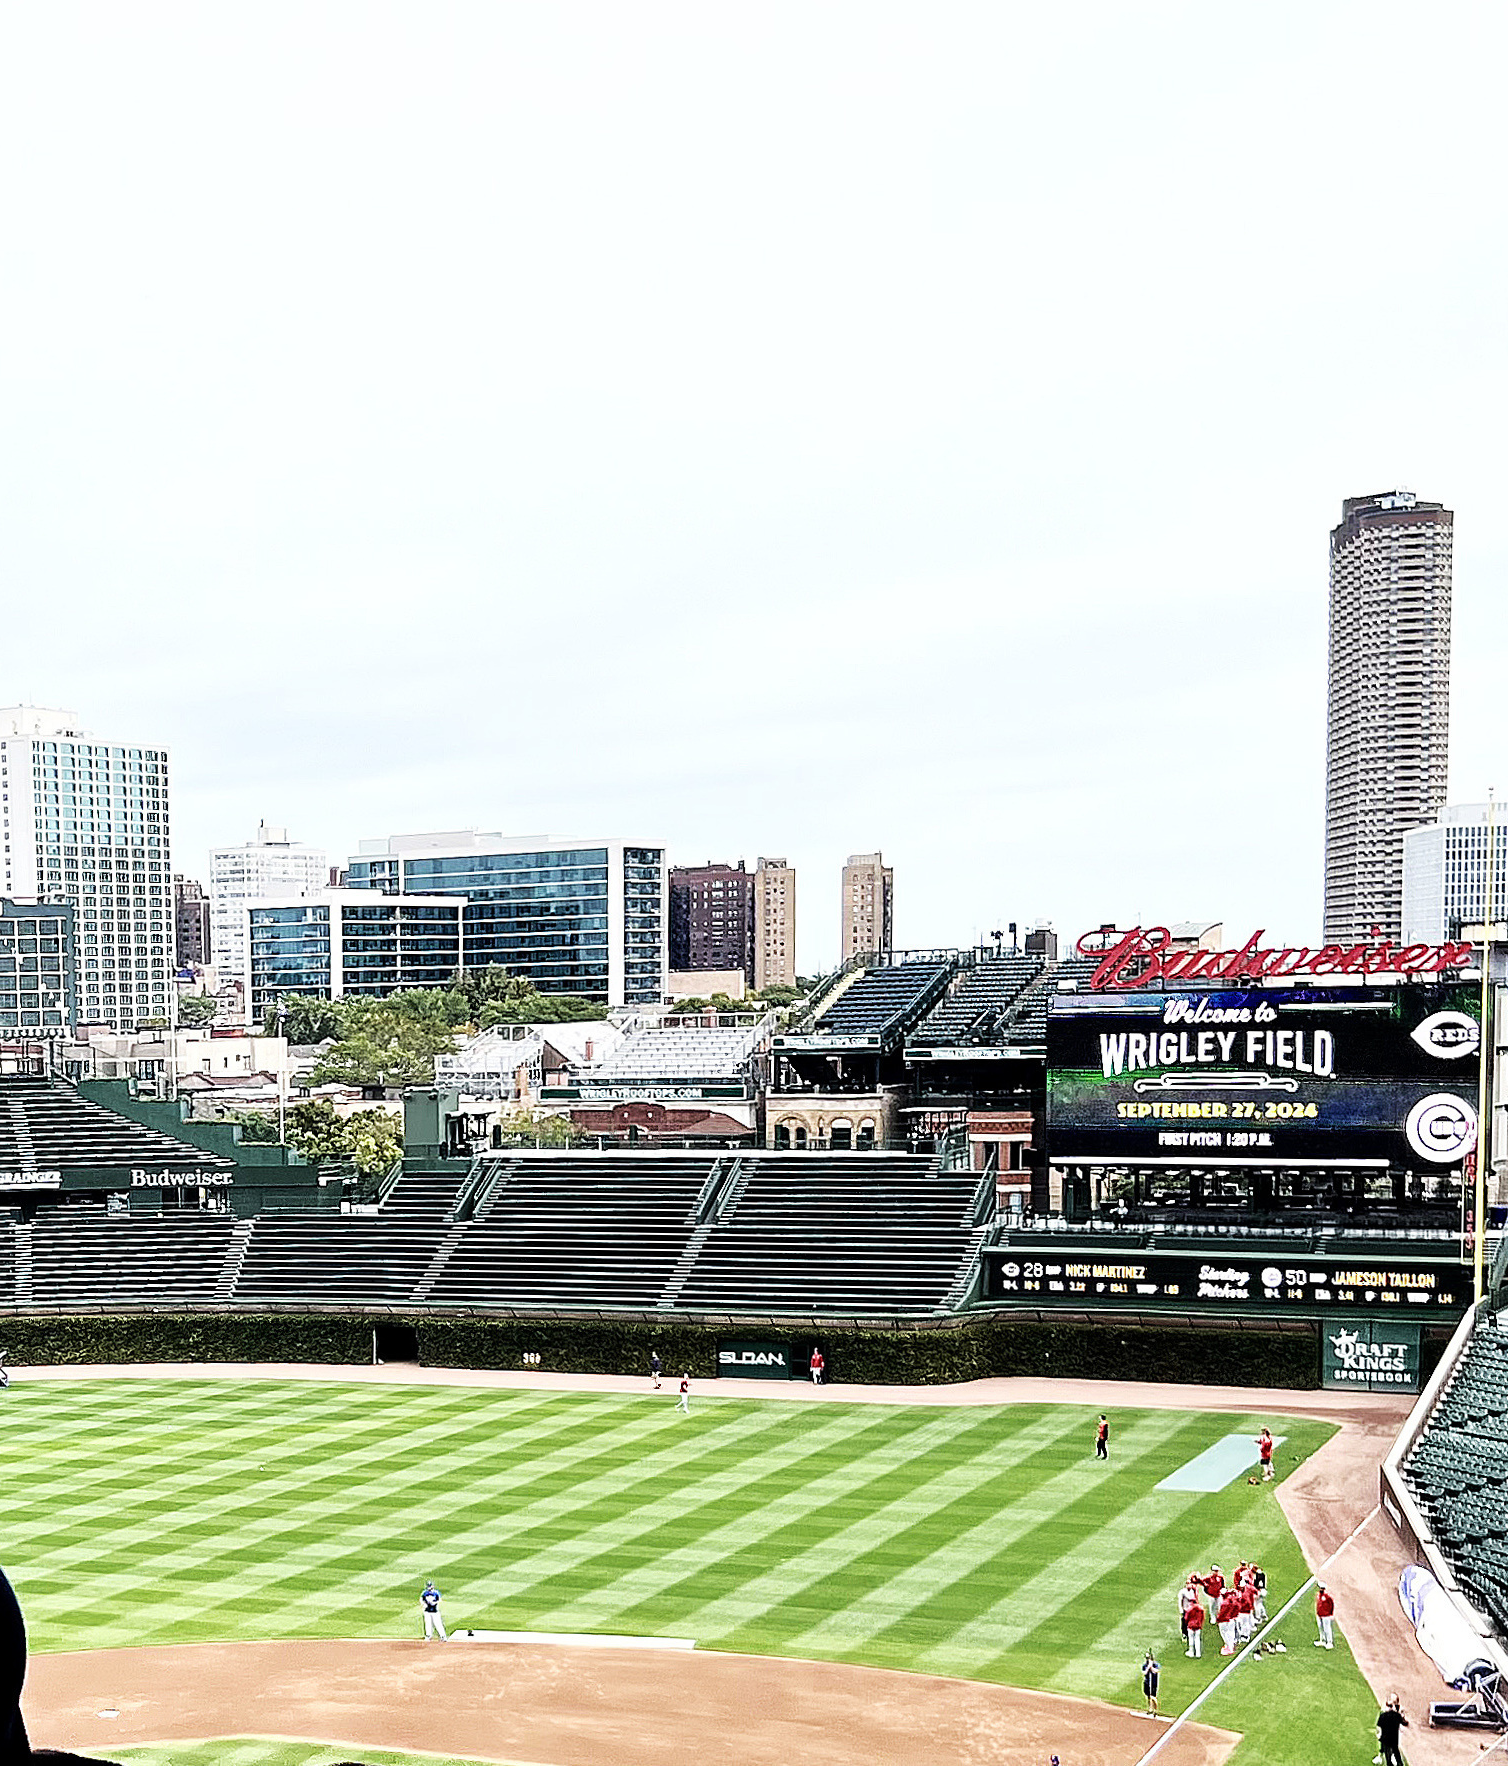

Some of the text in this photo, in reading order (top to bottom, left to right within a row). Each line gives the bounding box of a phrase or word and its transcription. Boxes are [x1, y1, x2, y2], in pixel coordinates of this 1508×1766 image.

[1076, 926, 1475, 989] Budweiser
[1163, 998, 1278, 1025] Welcome to
[1432, 1027, 1479, 1043] REDS
[1100, 1029, 1335, 1079] WRIGLEY FIELD
[1116, 1102, 1319, 1119] SEPTEMBER 27, 2024
[1158, 1132, 1190, 1146] FIRST
[1190, 1132, 1222, 1146] PITCH
[130, 1169, 233, 1187] Budweiser
[1023, 1262, 1044, 1278] 28
[1065, 1264, 1091, 1278] NICK
[1092, 1265, 1147, 1279] MARTINEZ
[1285, 1269, 1307, 1286] 50
[1331, 1271, 1386, 1287] JAMESON
[1389, 1272, 1436, 1288] TAILLON
[1334, 1341, 1408, 1358] DRAFT
[1343, 1355, 1406, 1371] KINGS
[1334, 1370, 1412, 1383] SPORTSBOOK
